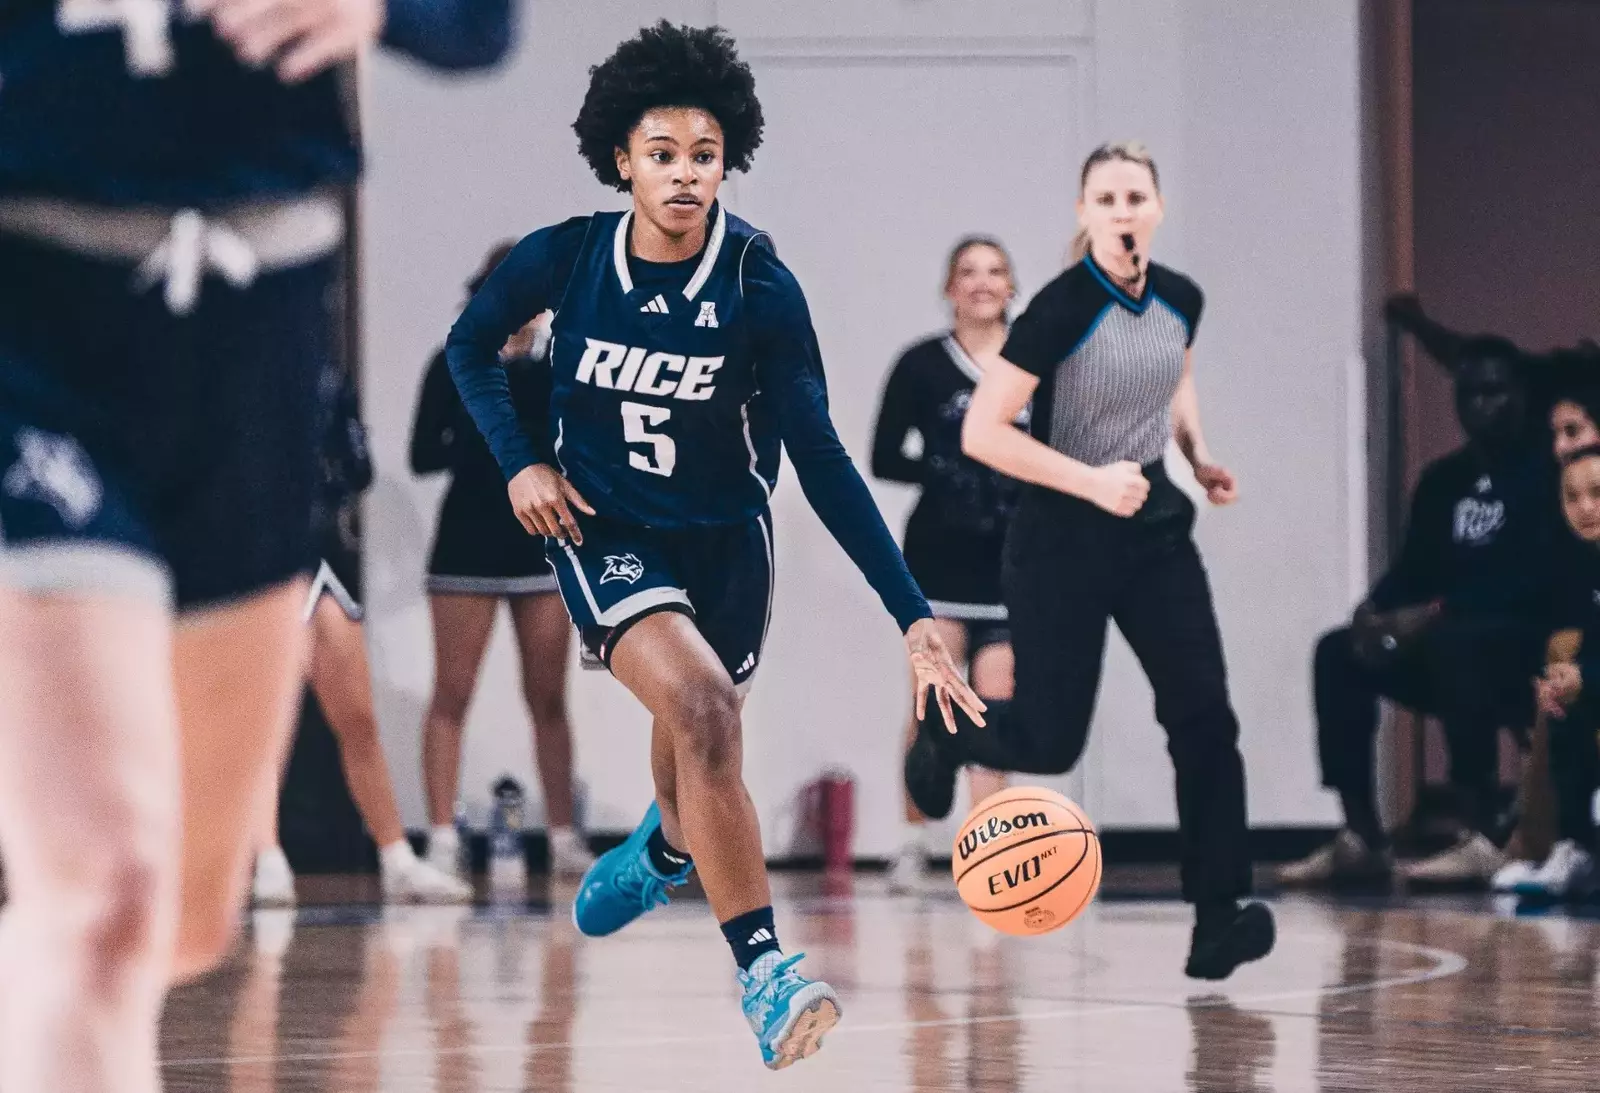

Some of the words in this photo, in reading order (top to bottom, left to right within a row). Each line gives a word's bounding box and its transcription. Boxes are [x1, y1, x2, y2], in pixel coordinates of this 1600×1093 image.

[575, 337, 725, 401] RICE
[621, 401, 676, 477] 5
[958, 811, 1049, 861] Wilson
[988, 855, 1042, 896] EVO
[1041, 846, 1058, 861] NXT
